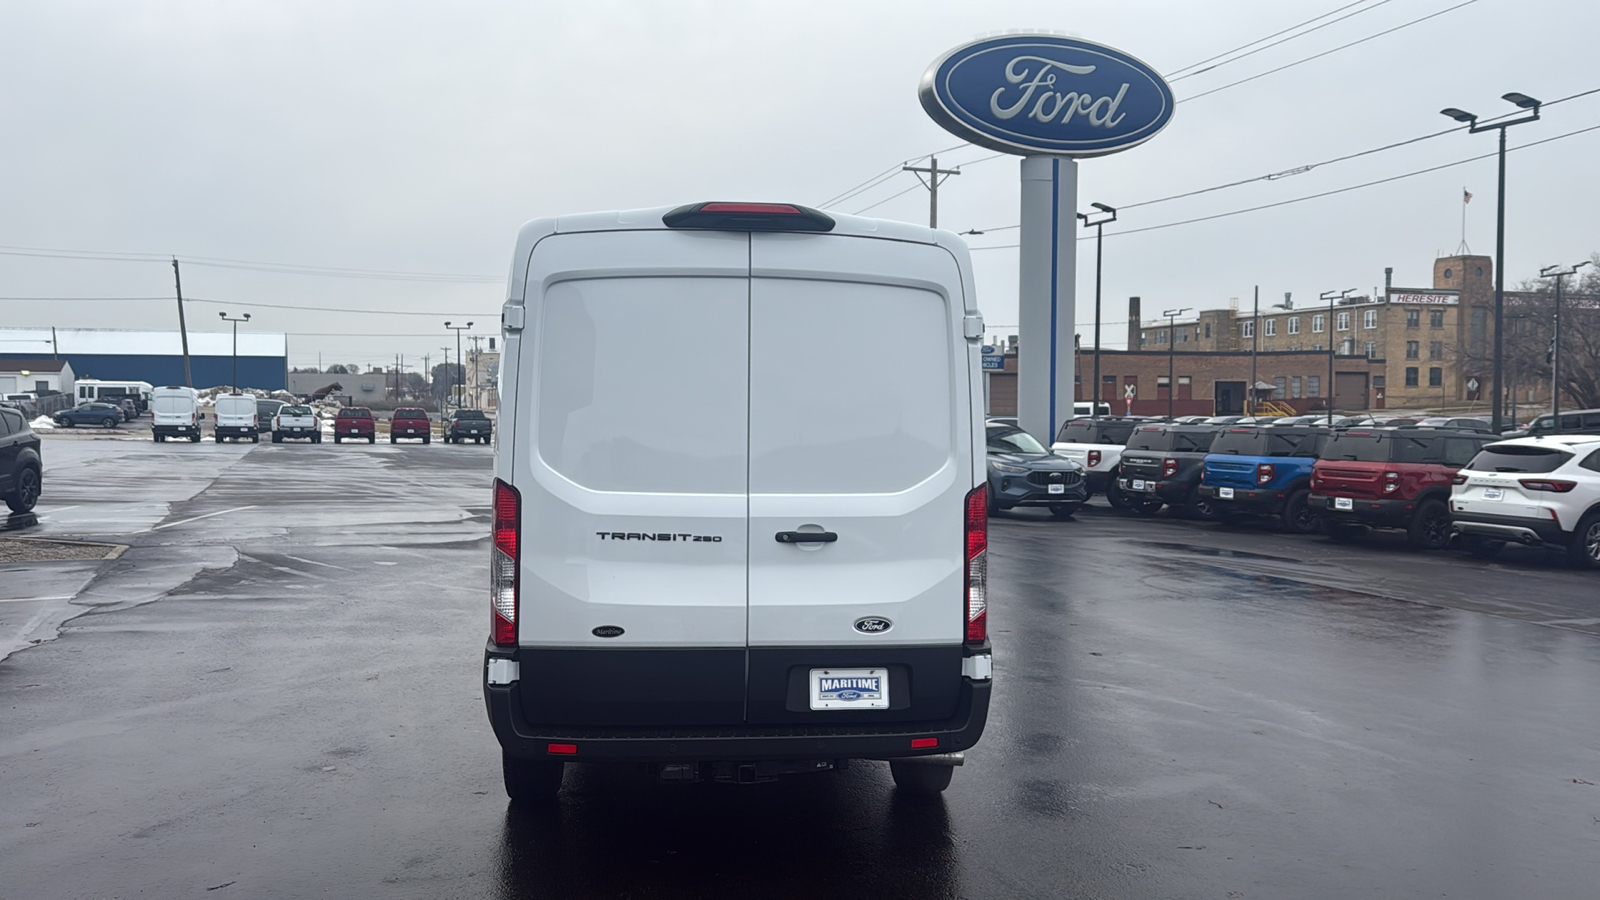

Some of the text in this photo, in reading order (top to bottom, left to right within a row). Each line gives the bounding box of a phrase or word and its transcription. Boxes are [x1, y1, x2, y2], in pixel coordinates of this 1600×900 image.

[990, 55, 1130, 129] Ford
[1397, 294, 1450, 304] HERESITE
[596, 532, 692, 542] TRANSIT
[861, 620, 885, 630] Ford
[821, 678, 878, 692] MARITIME
